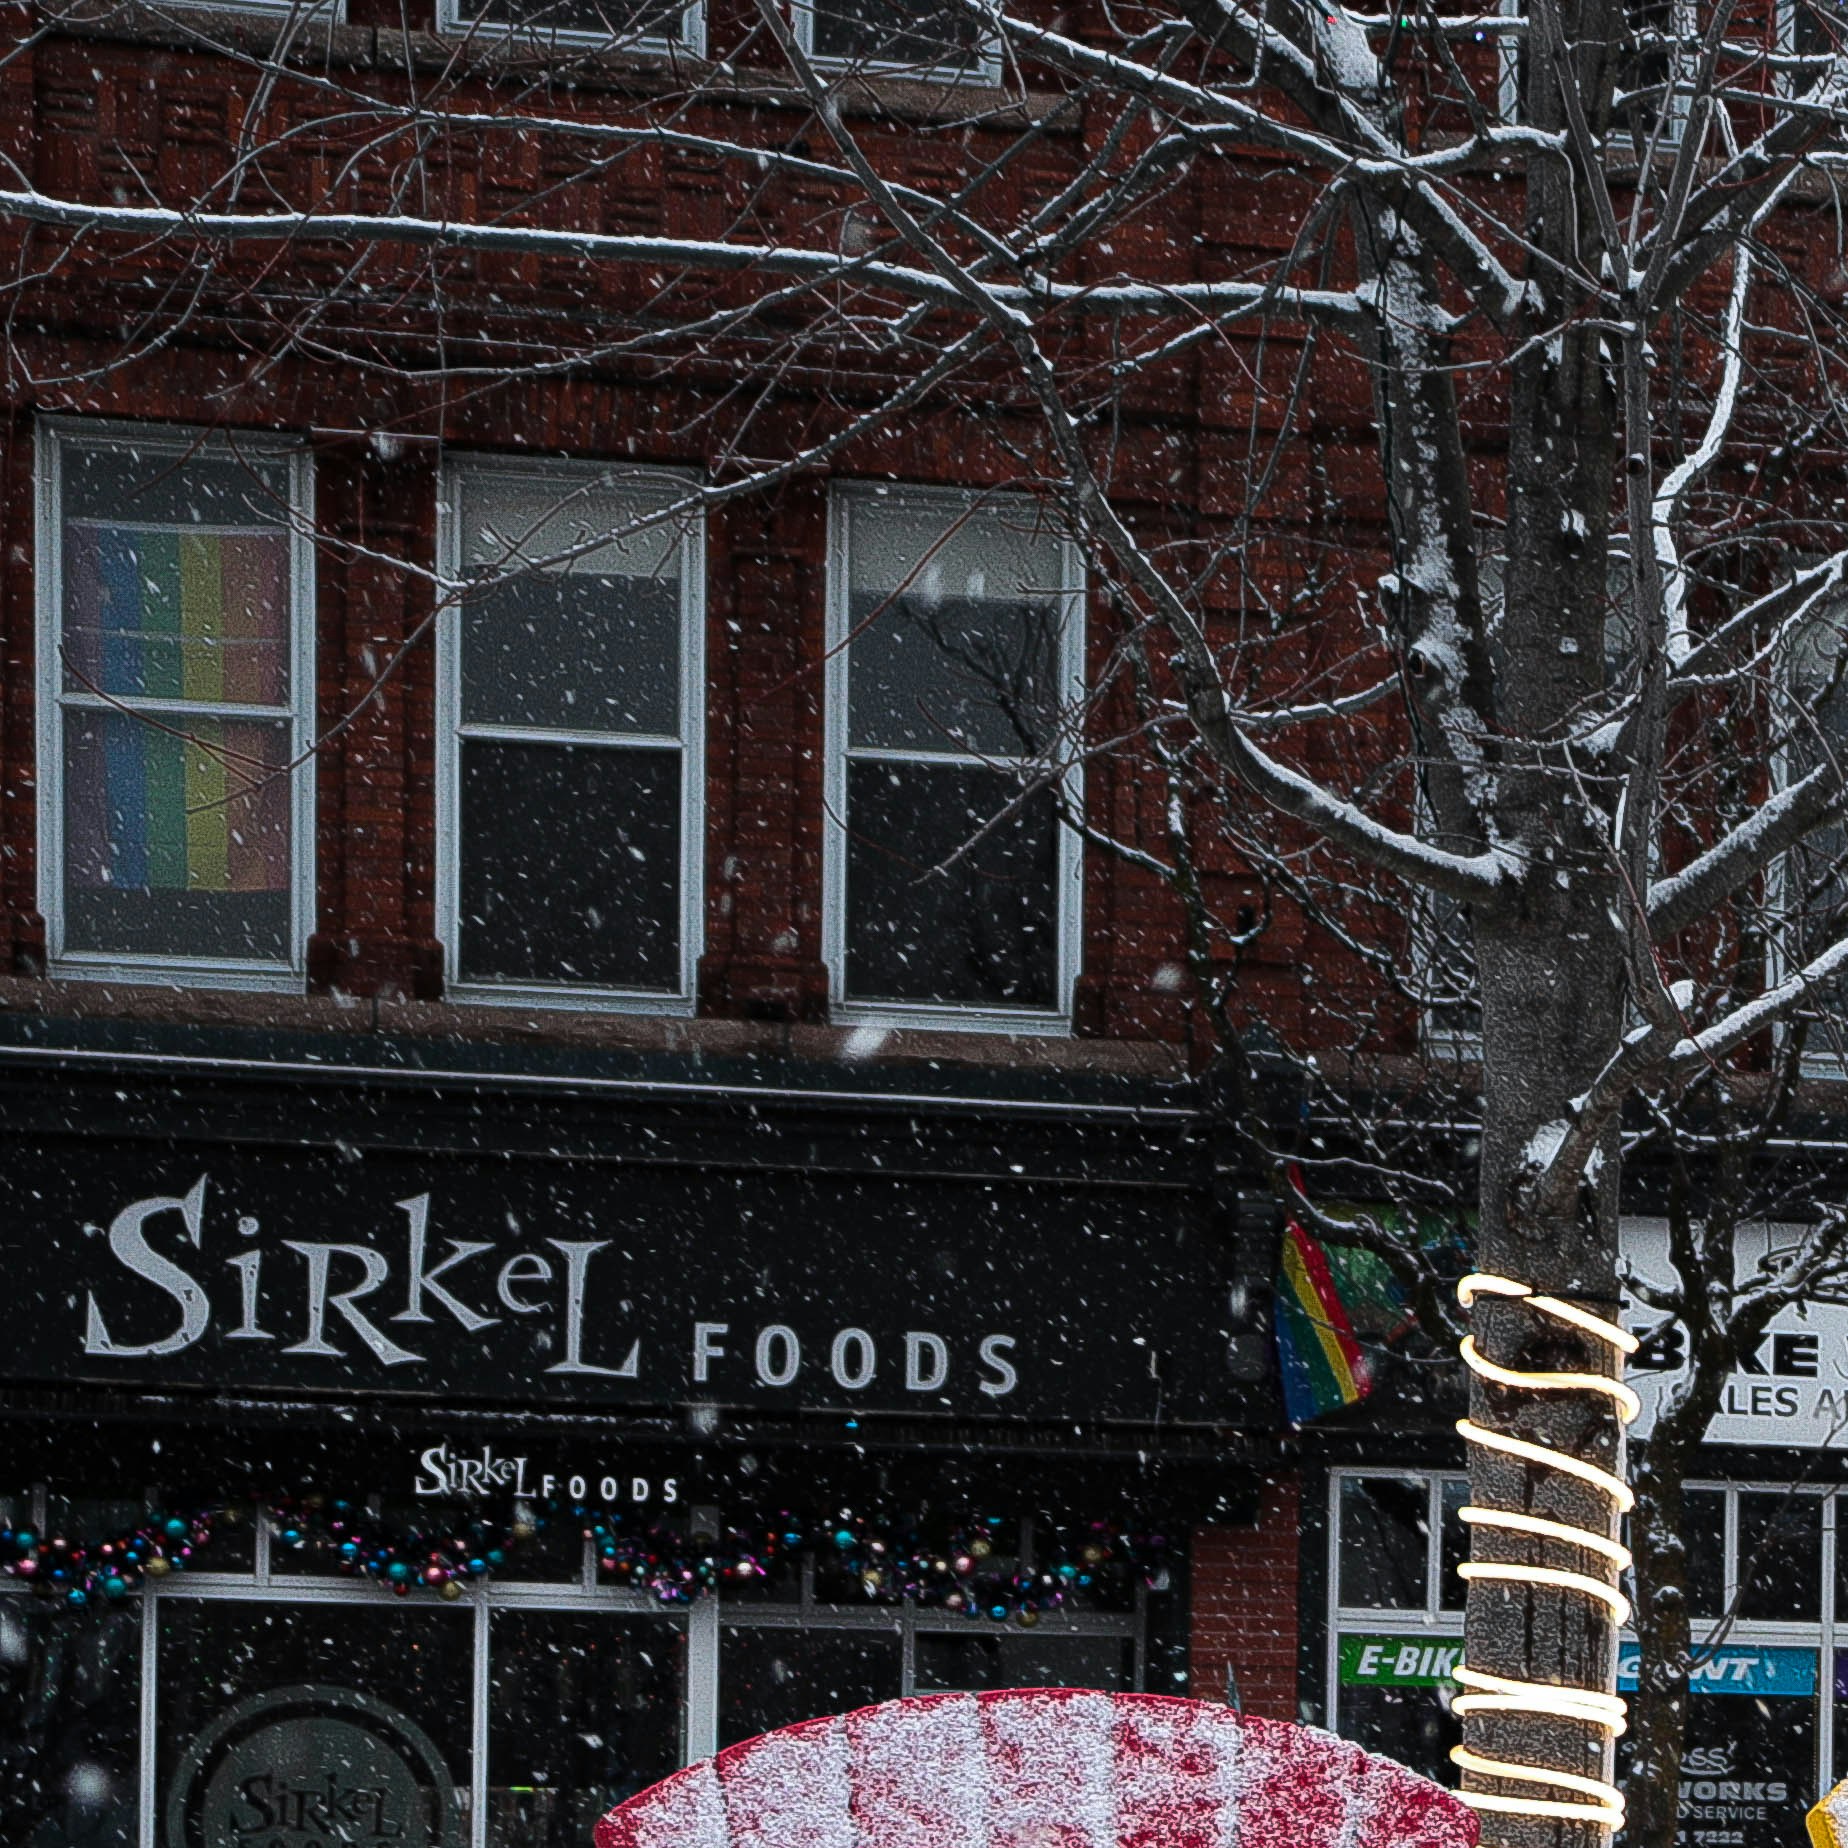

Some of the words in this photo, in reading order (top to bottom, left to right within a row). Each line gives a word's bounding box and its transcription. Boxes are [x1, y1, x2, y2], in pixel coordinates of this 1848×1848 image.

[693, 1321, 1019, 1397] FOODS
[1627, 1326, 1819, 1378] BKE
[541, 1475, 679, 1503] FOODS
[1356, 1644, 1466, 1678] E-BIK
[1693, 1805, 1768, 1821] SERVICE
